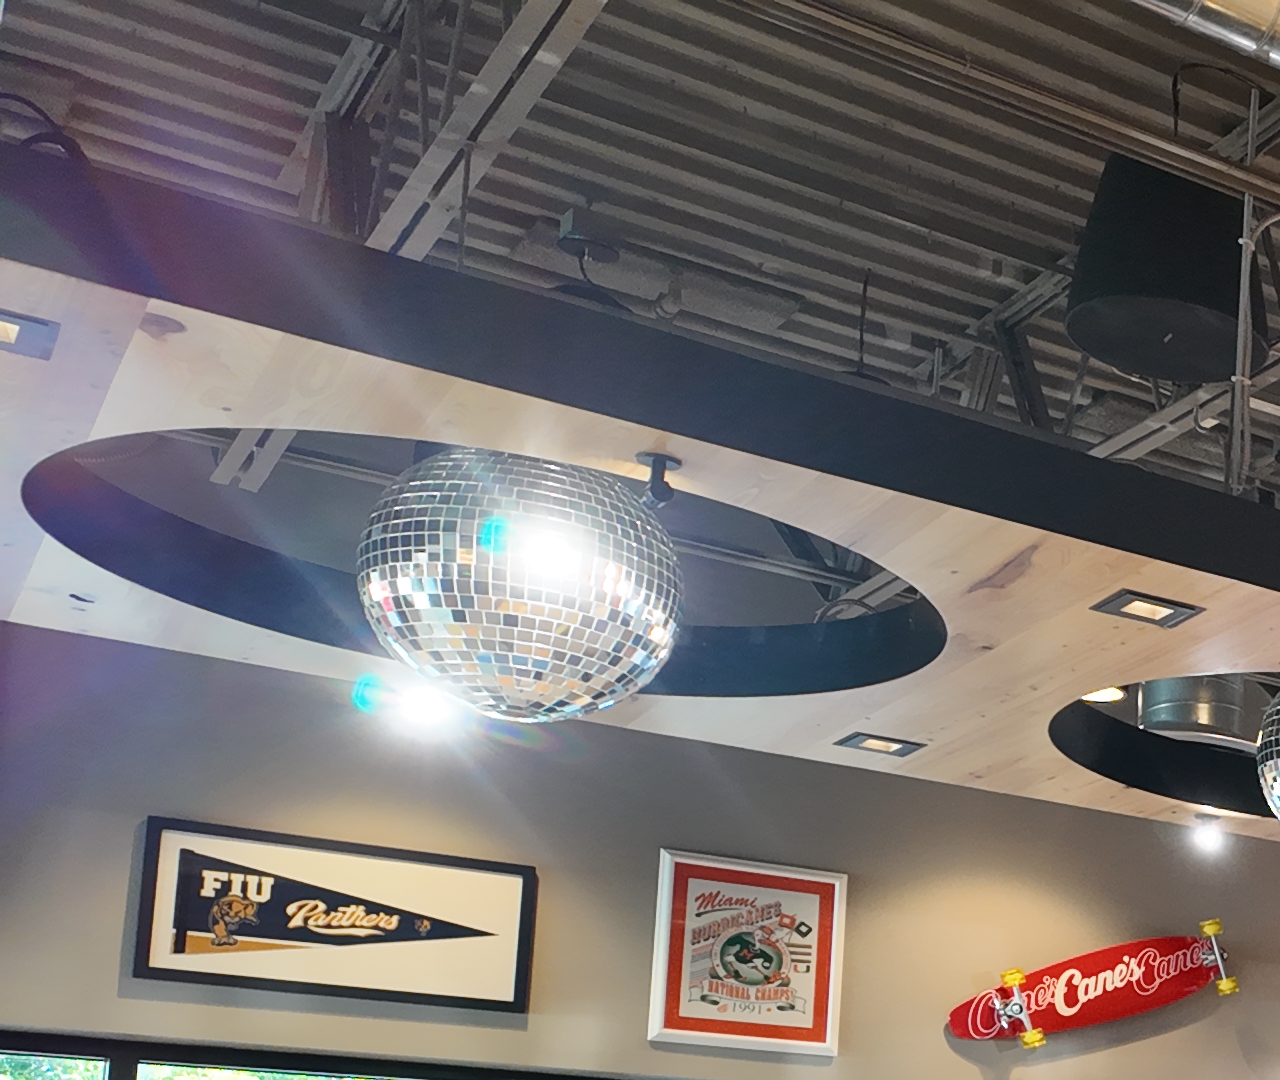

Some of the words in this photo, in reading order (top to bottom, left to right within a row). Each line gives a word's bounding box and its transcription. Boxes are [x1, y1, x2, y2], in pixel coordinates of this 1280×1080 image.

[200, 869, 275, 904] FIU
[694, 890, 758, 911] Miami
[285, 899, 401, 933] Panthers
[691, 900, 782, 946] HURRICANES
[707, 980, 751, 1001] NATIONAL
[968, 975, 1058, 1040] Cne's
[1054, 955, 1145, 1017] Cane's
[731, 1002, 763, 1015] 1991
